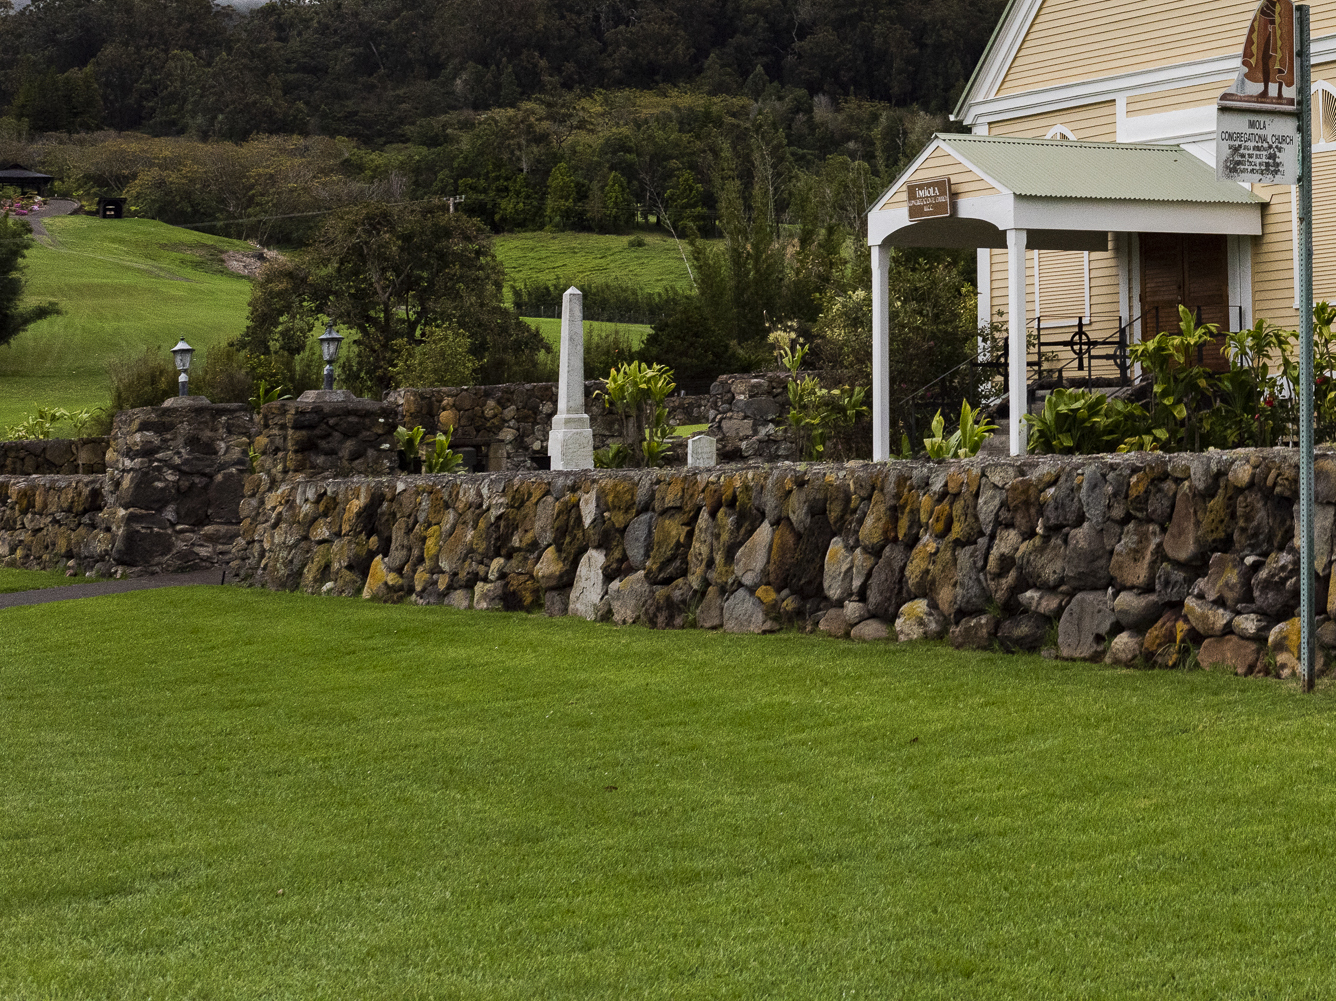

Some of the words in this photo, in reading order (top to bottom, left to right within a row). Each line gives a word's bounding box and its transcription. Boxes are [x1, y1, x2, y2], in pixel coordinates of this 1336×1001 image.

[1248, 119, 1267, 130] IMIOLA
[1221, 131, 1269, 144] CONGREGATIONAL
[1271, 134, 1294, 145] CHURCH
